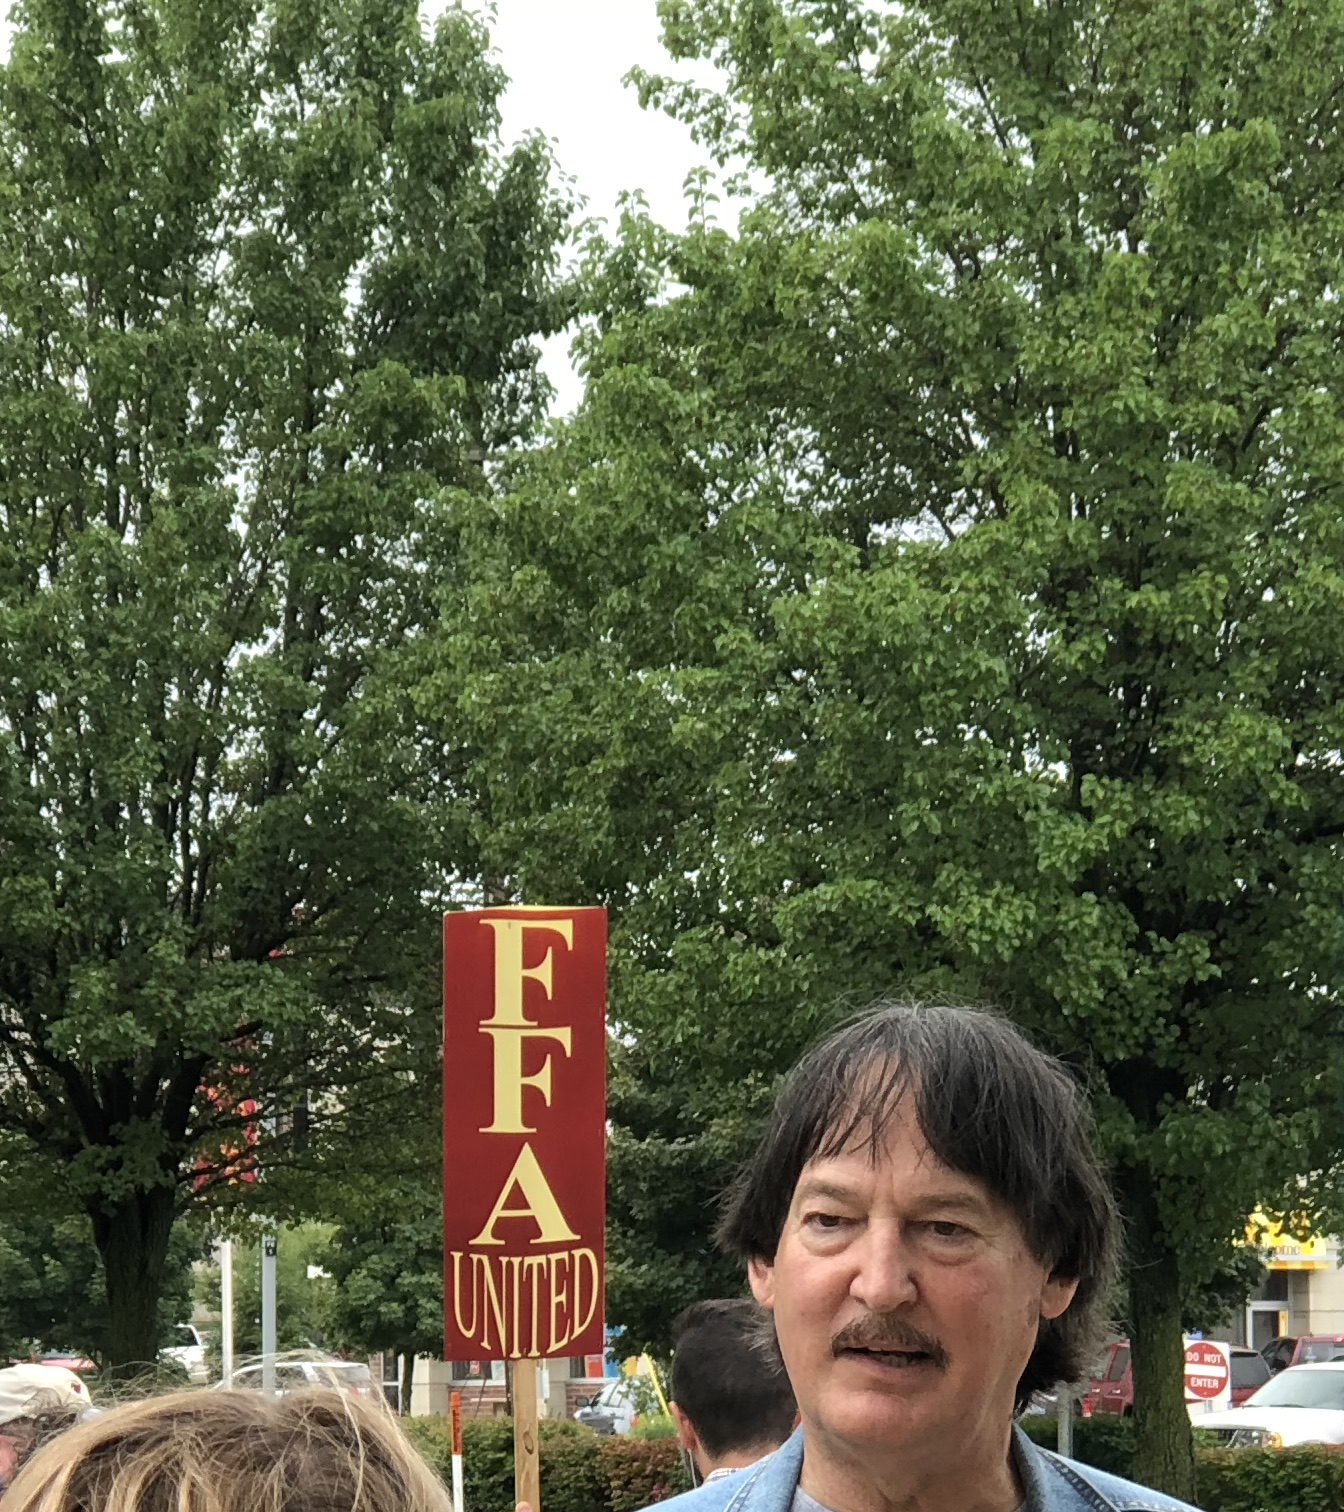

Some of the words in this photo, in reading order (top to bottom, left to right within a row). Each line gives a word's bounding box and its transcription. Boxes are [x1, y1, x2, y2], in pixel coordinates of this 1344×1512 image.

[469, 918, 581, 1245] FFA
[450, 1246, 600, 1360] UNITED
[1186, 1351, 1200, 1362] DO
[1203, 1353, 1222, 1364] NOT
[1190, 1376, 1219, 1389] ENTER
